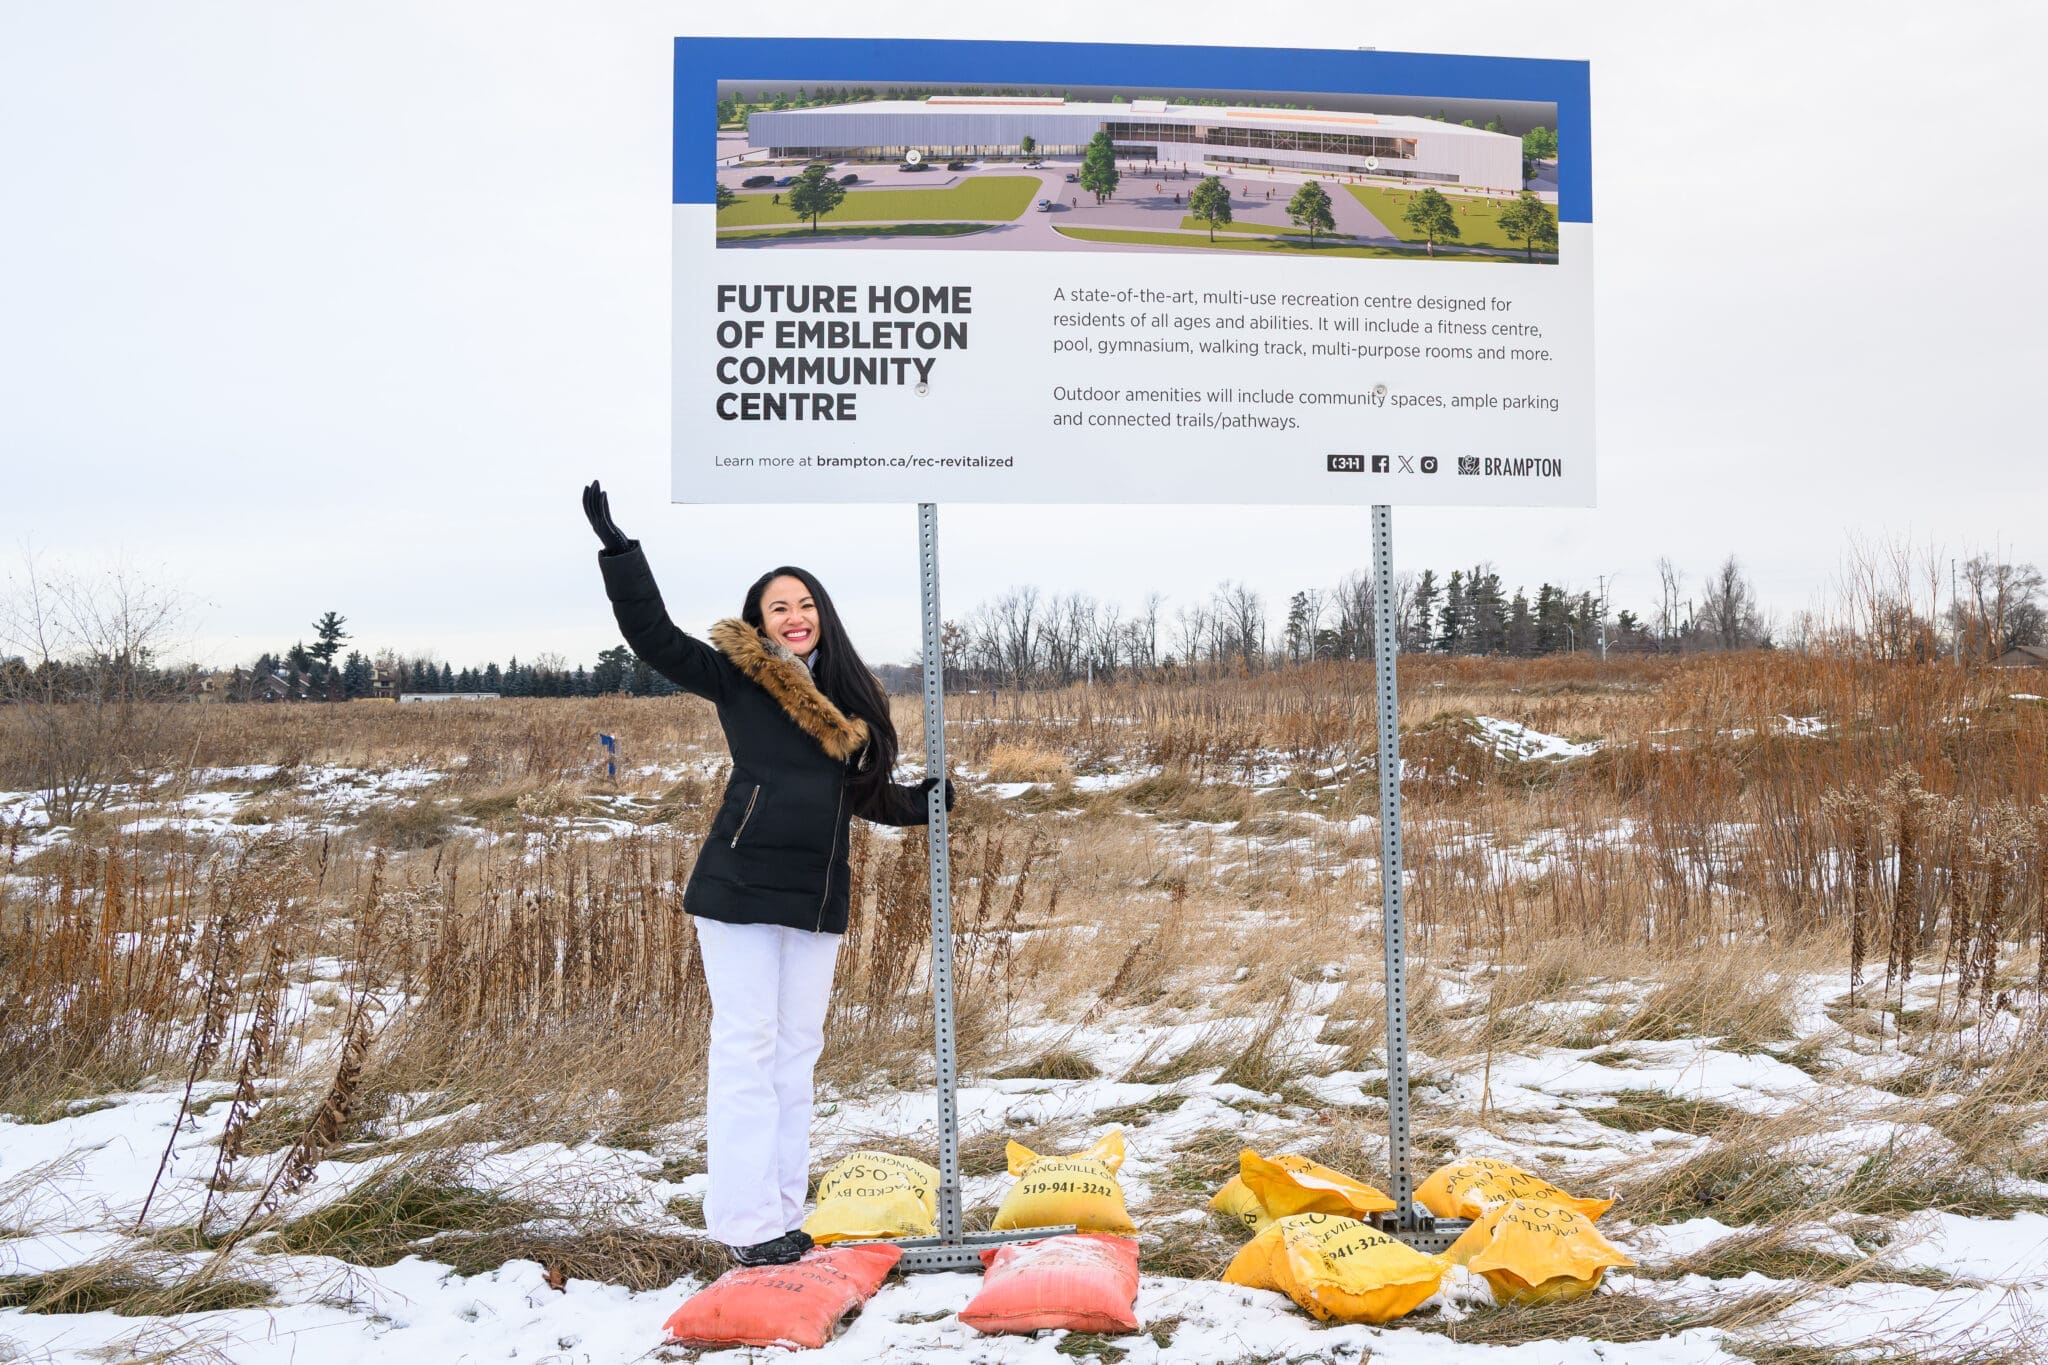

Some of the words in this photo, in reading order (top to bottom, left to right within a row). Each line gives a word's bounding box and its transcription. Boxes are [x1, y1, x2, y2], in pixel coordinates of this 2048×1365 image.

[716, 284, 858, 314] FUTURE
[868, 284, 973, 315] HOME
[1053, 287, 1066, 302] A
[1070, 287, 1198, 306] state-of-the-art,
[1203, 289, 1277, 306] multi-use
[1281, 292, 1359, 308] recreation
[1364, 294, 1413, 309] centre
[1416, 294, 1486, 313] designed
[1490, 296, 1513, 312] for
[716, 319, 765, 350] OF
[775, 320, 968, 351] EMBLETON
[1053, 311, 1126, 328] residents
[1130, 312, 1147, 328] of
[1151, 312, 1169, 328] all
[1173, 316, 1211, 331] ages
[1215, 314, 1245, 330] and
[1249, 314, 1313, 331] abilities.
[1318, 316, 1329, 331] It
[1333, 316, 1359, 332] will
[1364, 317, 1420, 334] include
[1423, 322, 1433, 334] a
[1437, 319, 1487, 336] fitness
[1491, 322, 1542, 339] centre,
[1053, 336, 1093, 354] pool,
[1097, 337, 1194, 355] gymnasium,
[1198, 338, 1259, 357] walking
[1263, 340, 1307, 357] track,
[1311, 340, 1421, 360] multi-purpose
[1425, 346, 1473, 359] rooms
[1477, 345, 1506, 360] and
[1510, 348, 1553, 361] more.
[716, 356, 937, 385] COMMUNITY
[715, 392, 857, 422] CENTRE
[1053, 386, 1121, 402] Outdoor
[1125, 386, 1202, 403] amenities
[1206, 387, 1233, 403] will
[1238, 388, 1295, 404] include
[1298, 391, 1386, 408] community
[1390, 394, 1447, 409] spaces,
[1450, 393, 1498, 411] ample
[1502, 394, 1559, 413] parking
[1053, 411, 1083, 426] and
[1088, 411, 1171, 427] connected
[1176, 411, 1300, 432] trails/pathways.
[715, 455, 754, 467] Learn
[758, 457, 795, 467] more
[798, 455, 813, 467] at
[816, 454, 1014, 469] brampton.ca/rec-revitalized
[1484, 457, 1562, 478] BRAMPTON
[1023, 1182, 1112, 1197] 519-941-3242
